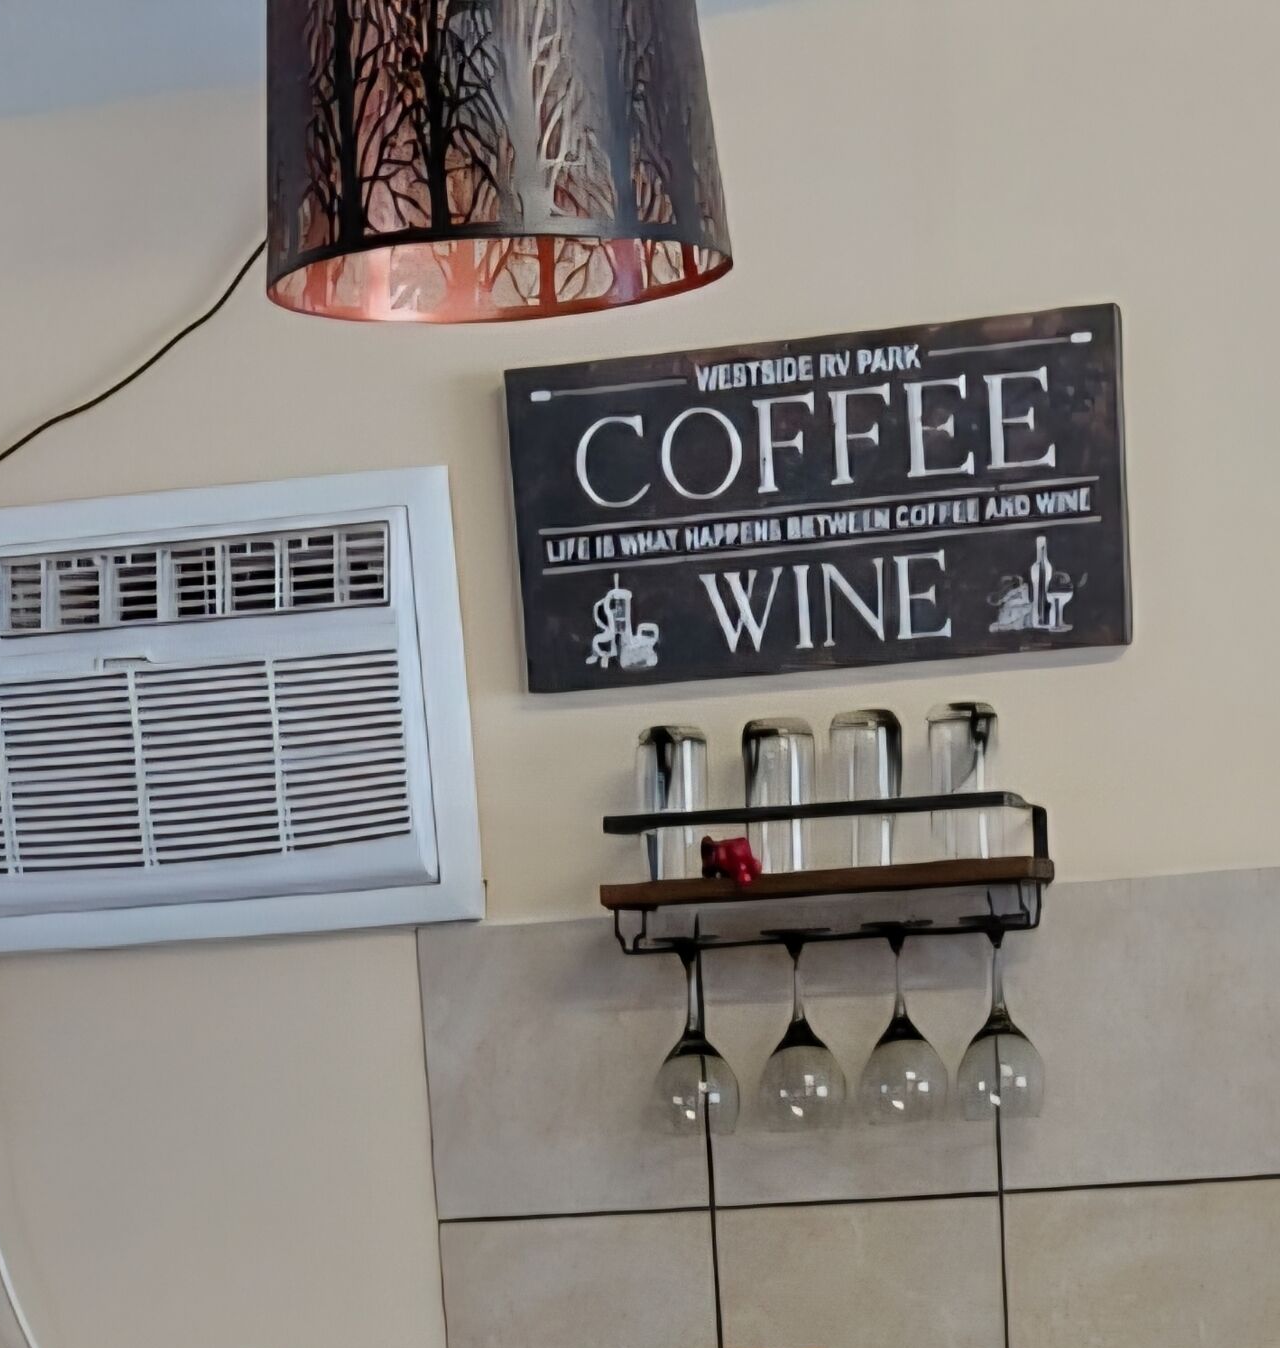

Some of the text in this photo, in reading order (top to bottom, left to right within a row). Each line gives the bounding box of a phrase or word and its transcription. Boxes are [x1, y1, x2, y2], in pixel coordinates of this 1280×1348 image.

[695, 344, 921, 391] WESTSIDE RV PARK
[575, 365, 1056, 508] COFFEE
[620, 529, 680, 556] WHAT
[896, 498, 980, 528] COFFEE
[985, 494, 1030, 520] AND
[1036, 487, 1091, 514] WINE
[698, 549, 951, 654] WINE
